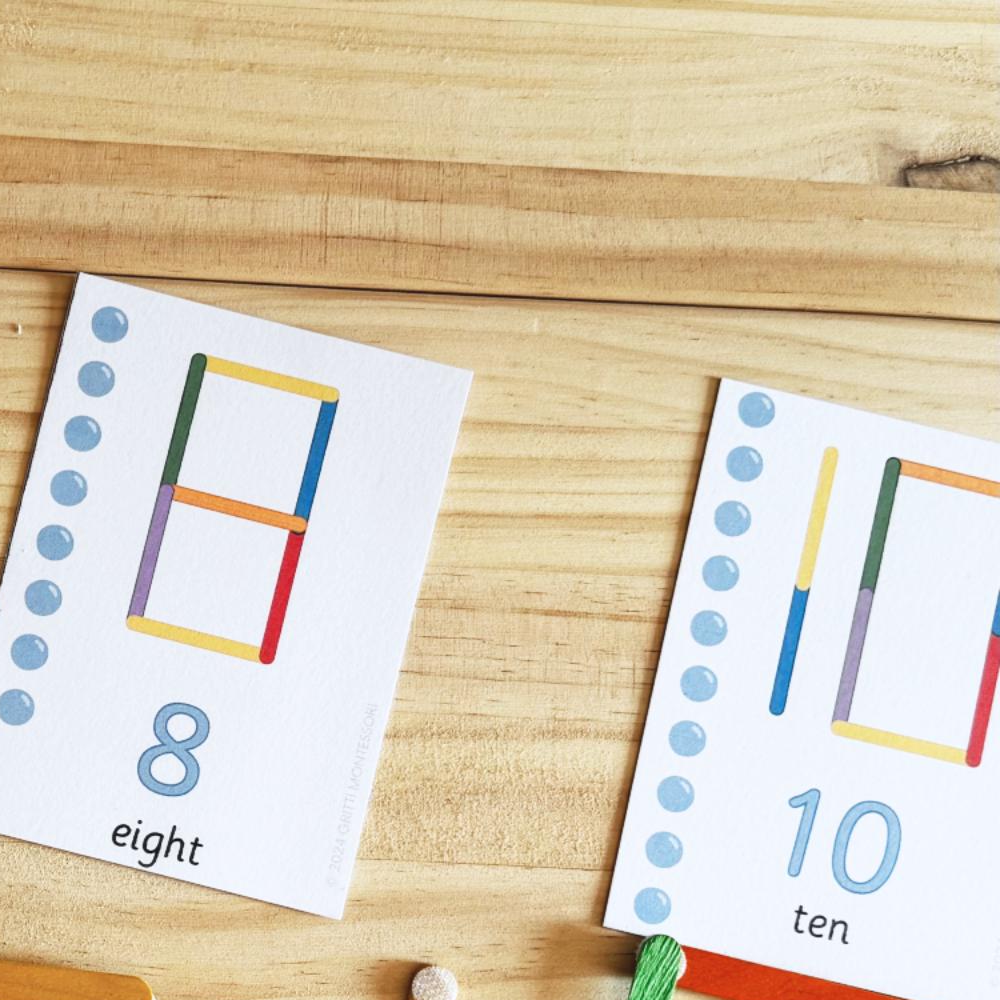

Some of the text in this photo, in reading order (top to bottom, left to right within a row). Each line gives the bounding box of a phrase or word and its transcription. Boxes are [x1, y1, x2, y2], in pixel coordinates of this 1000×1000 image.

[137, 702, 210, 797] 8
[346, 703, 380, 791] MONTESSORI
[337, 792, 358, 834] GRITTI
[111, 819, 204, 868] eight
[328, 838, 346, 873] 2024
[787, 788, 902, 895] 10
[793, 905, 849, 945] ten
